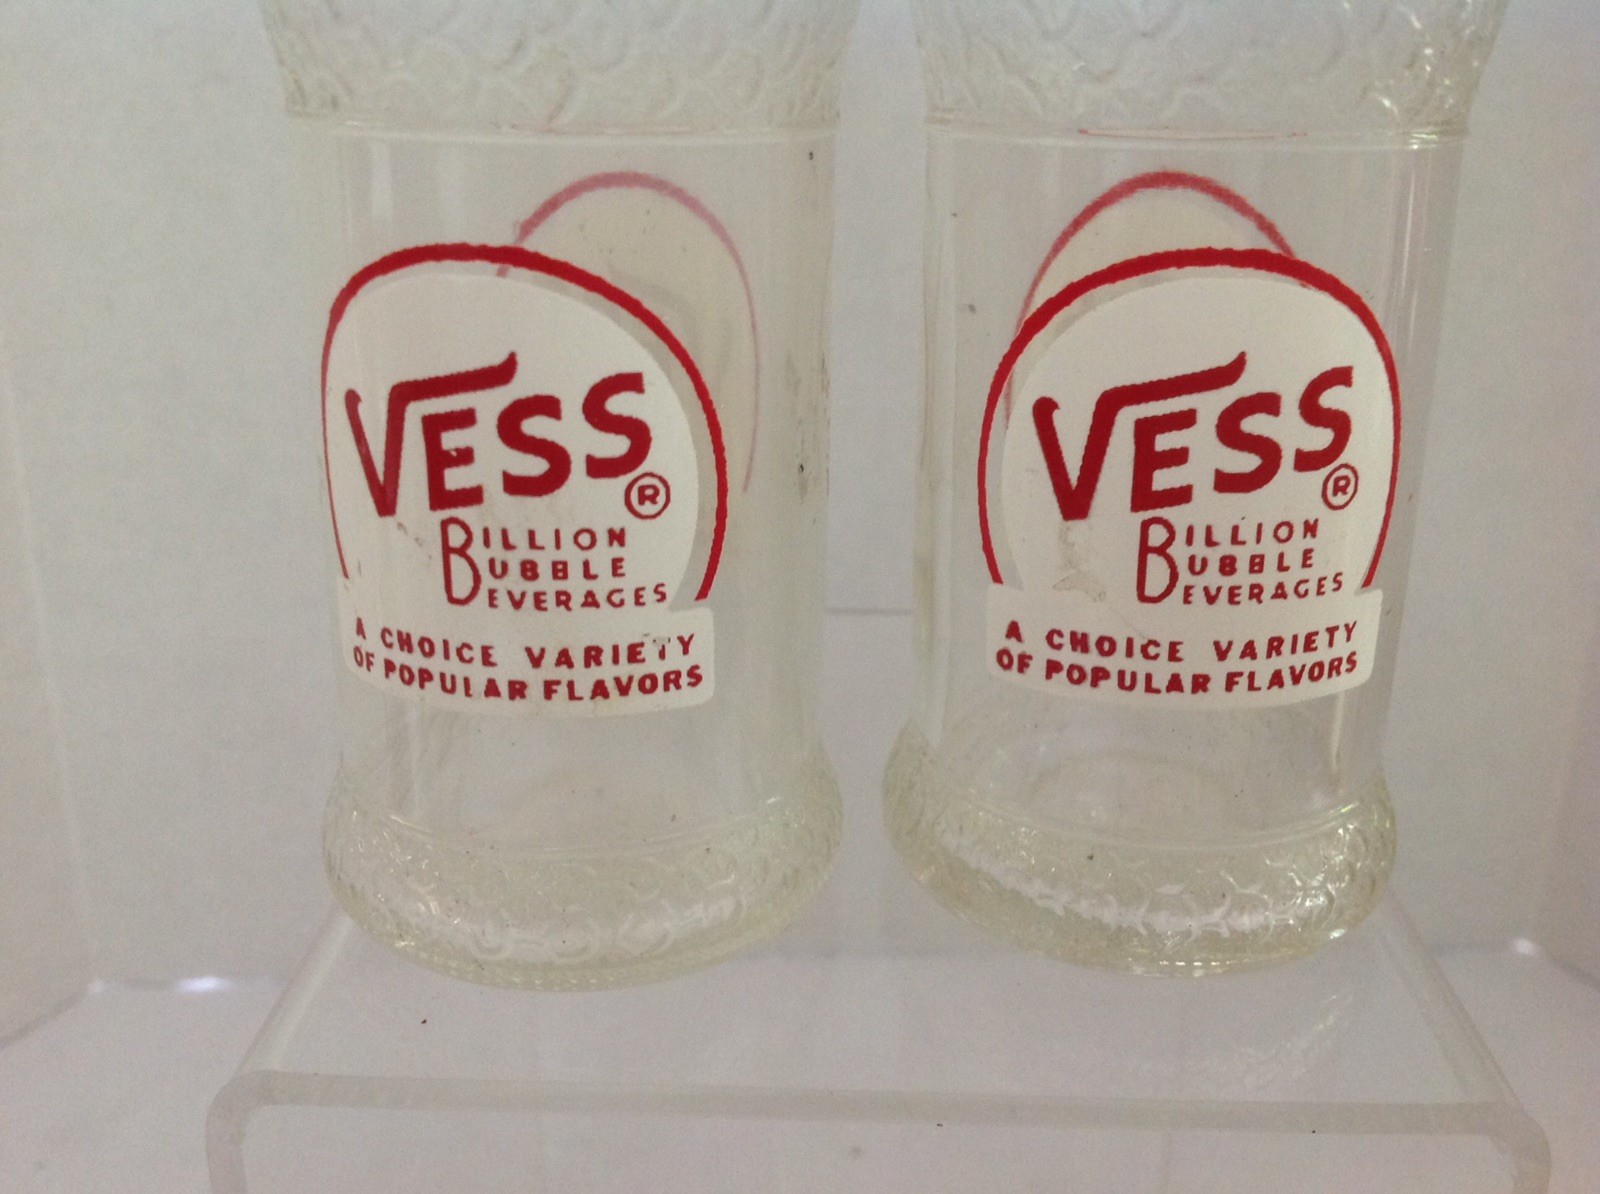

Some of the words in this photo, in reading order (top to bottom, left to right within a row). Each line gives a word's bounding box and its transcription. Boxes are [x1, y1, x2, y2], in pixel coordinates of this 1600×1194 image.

[345, 352, 653, 517] VESS
[1032, 352, 1354, 522] VESS
[354, 617, 367, 639] A
[380, 627, 497, 668] CHOICE
[1005, 620, 1024, 644] A
[1044, 628, 1184, 664] CHOICE
[1213, 622, 1358, 662] VARIETY
[353, 646, 376, 673] OF
[383, 657, 529, 701] POPULAR
[543, 663, 704, 702] FLAVORS
[995, 647, 1035, 675] OF
[1044, 658, 1212, 696] POPULAR
[1224, 651, 1359, 695] FLAVORS
